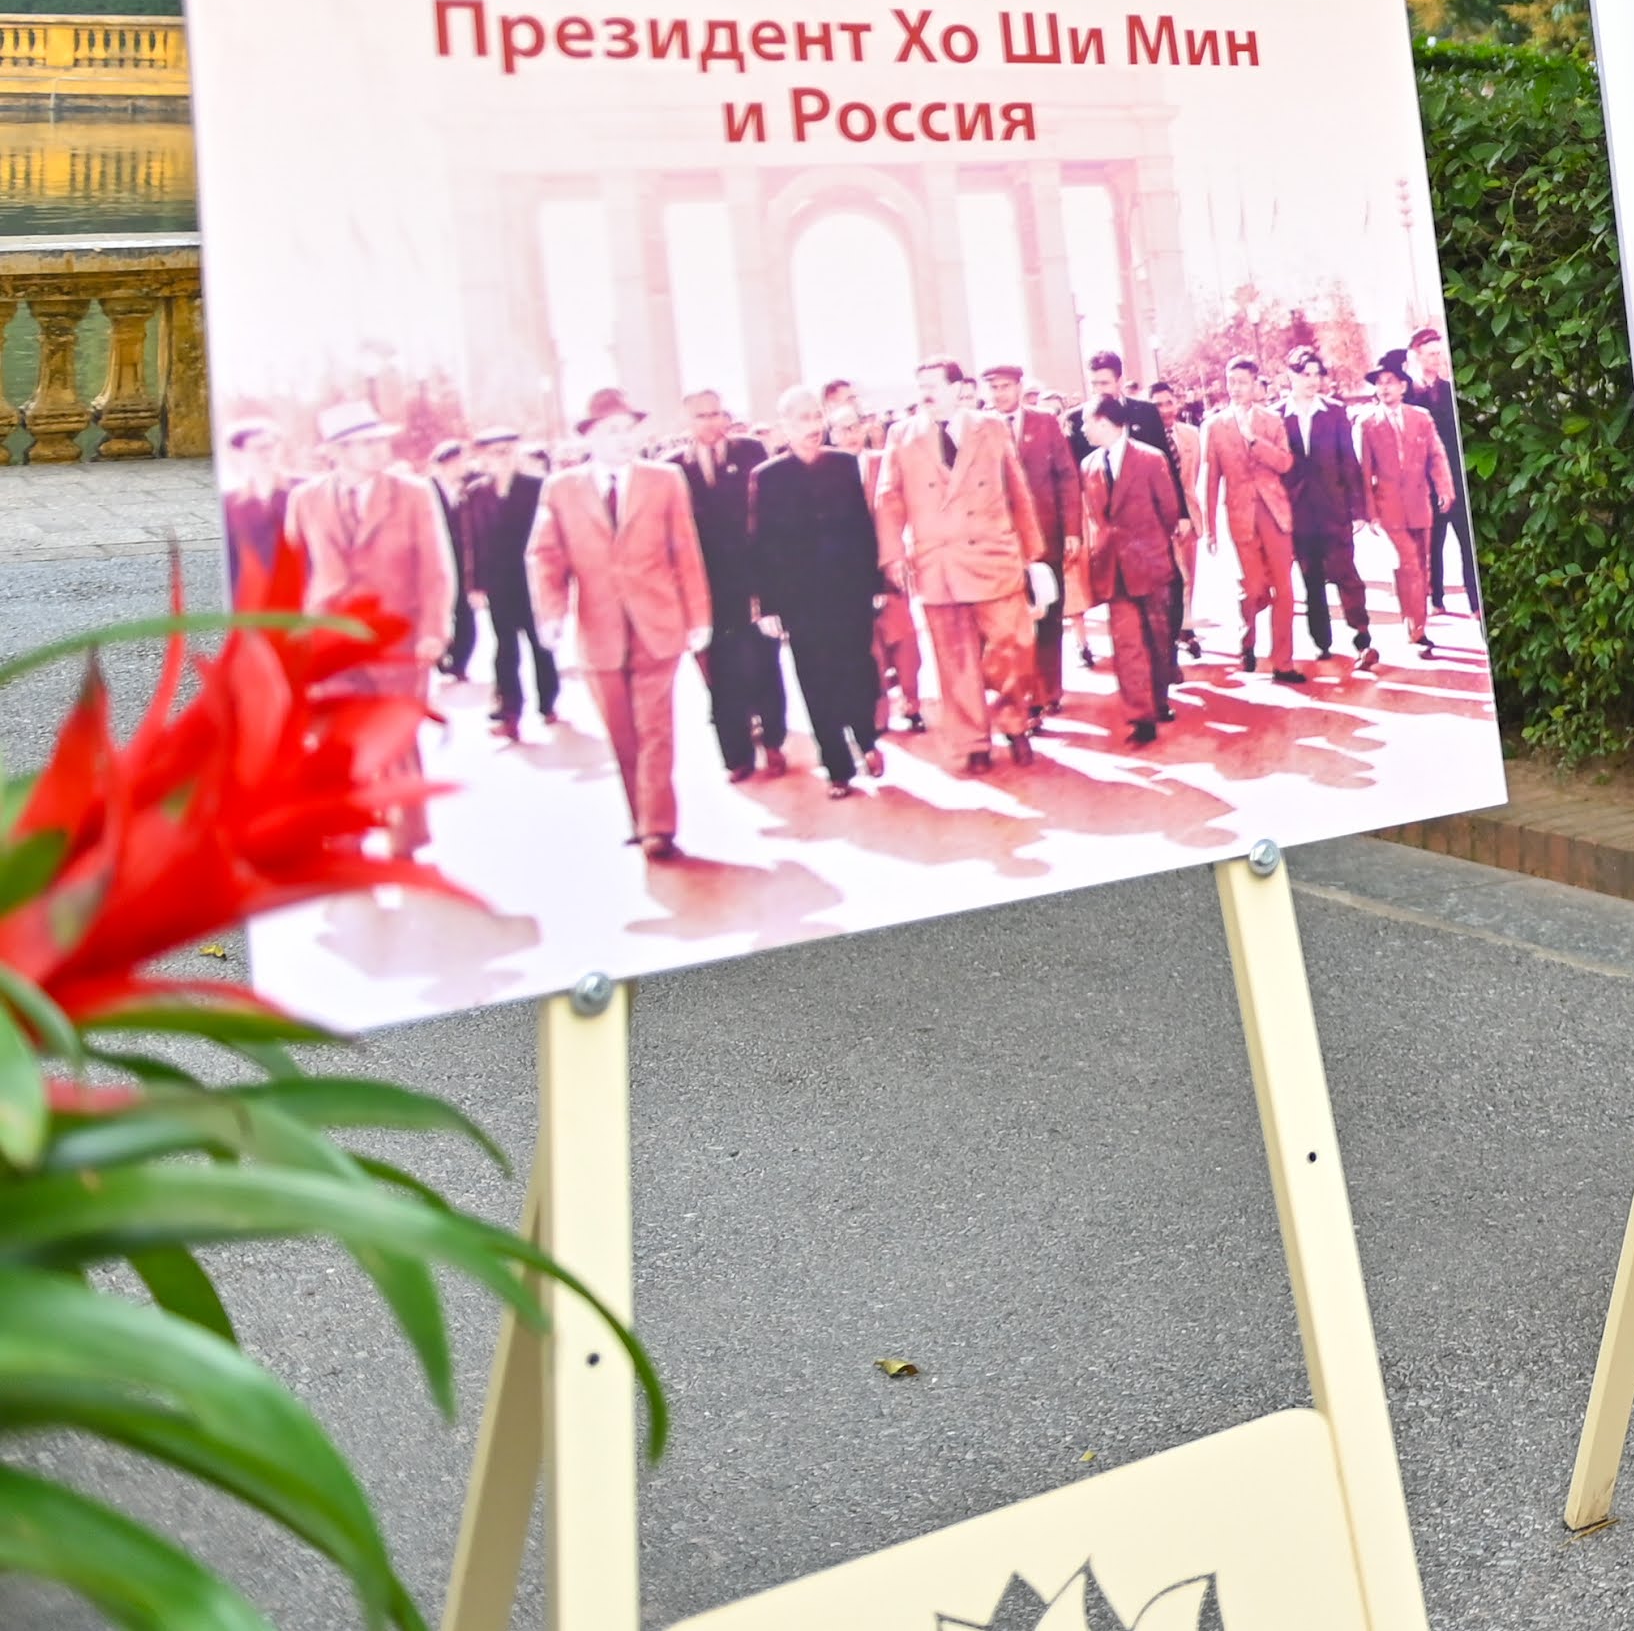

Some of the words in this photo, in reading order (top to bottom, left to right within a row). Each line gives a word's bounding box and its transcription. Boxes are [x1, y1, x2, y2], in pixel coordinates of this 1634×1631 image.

[891, 8, 979, 64] Хо
[998, 11, 1105, 64] Ши
[1125, 14, 1259, 66] Мин
[722, 102, 766, 142] и
[789, 86, 1036, 143] Россия
